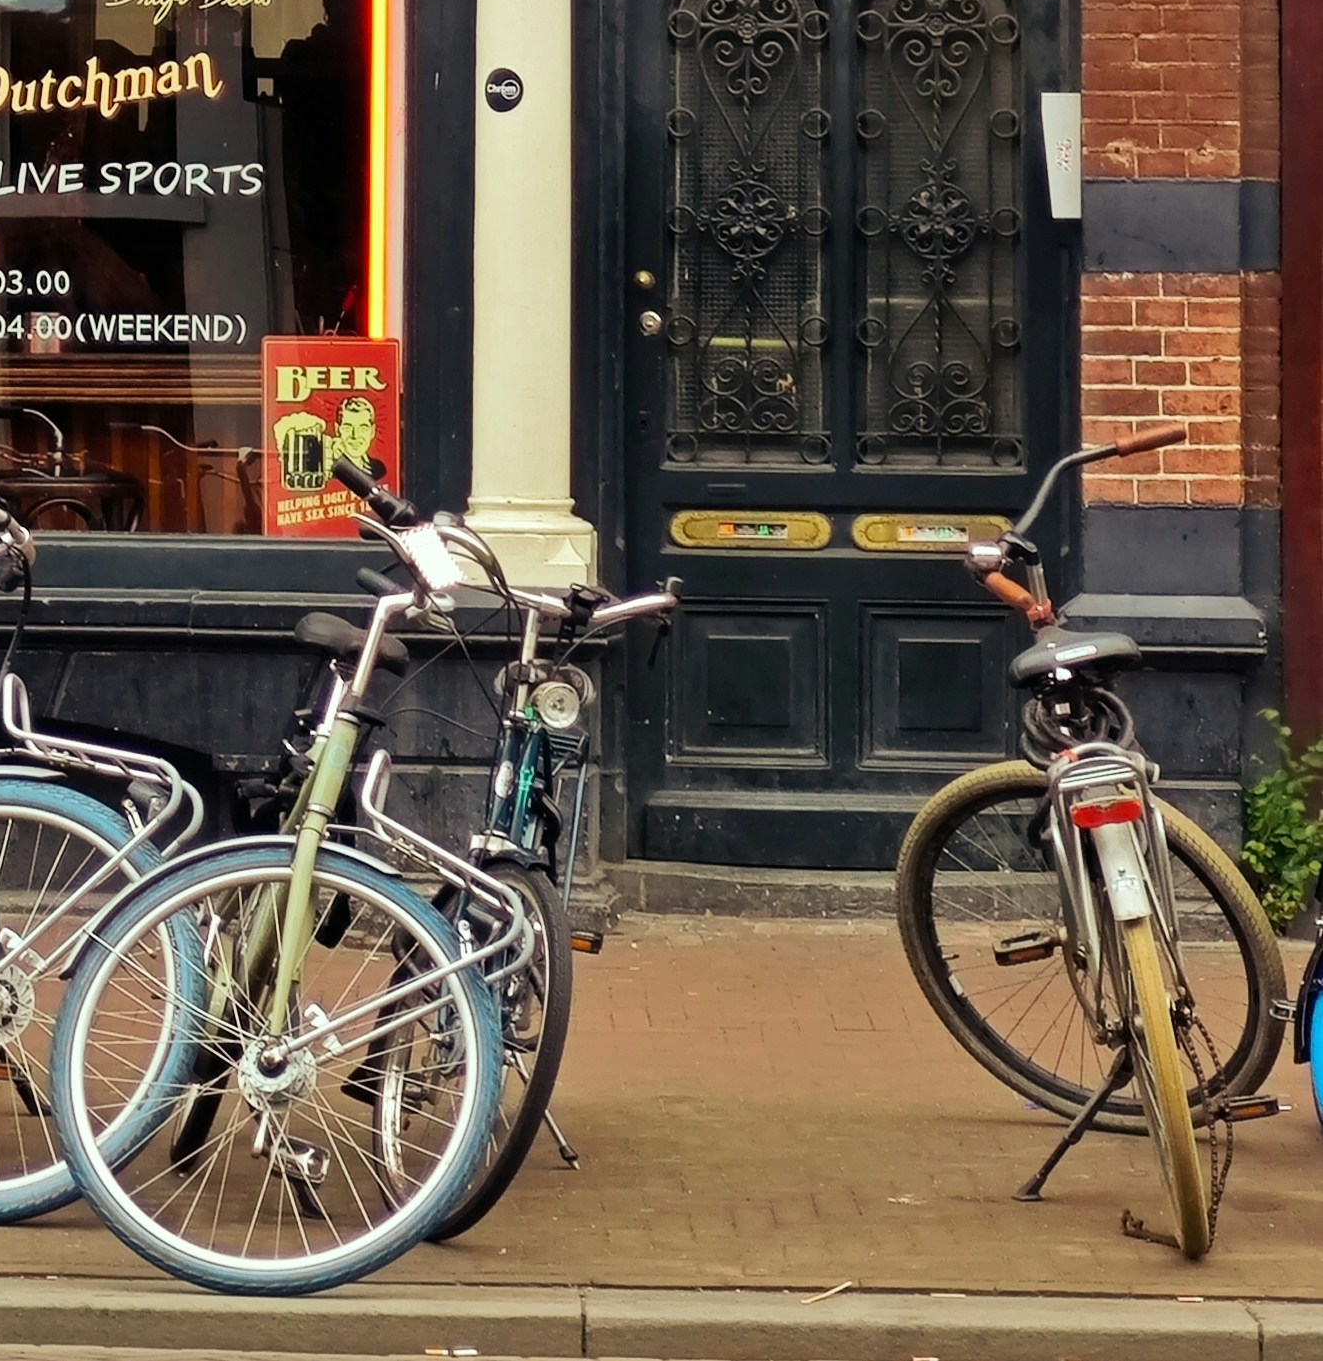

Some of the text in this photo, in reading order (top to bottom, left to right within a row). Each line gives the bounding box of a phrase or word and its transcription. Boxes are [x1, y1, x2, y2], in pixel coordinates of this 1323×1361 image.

[98, 161, 265, 197] SPORTS
[275, 365, 389, 403] BEER
[276, 511, 303, 527] HAVE
[305, 507, 326, 522] SEX
[327, 502, 357, 518] SINCE
[277, 495, 321, 513] HELPING
[322, 490, 348, 506] UGLY
